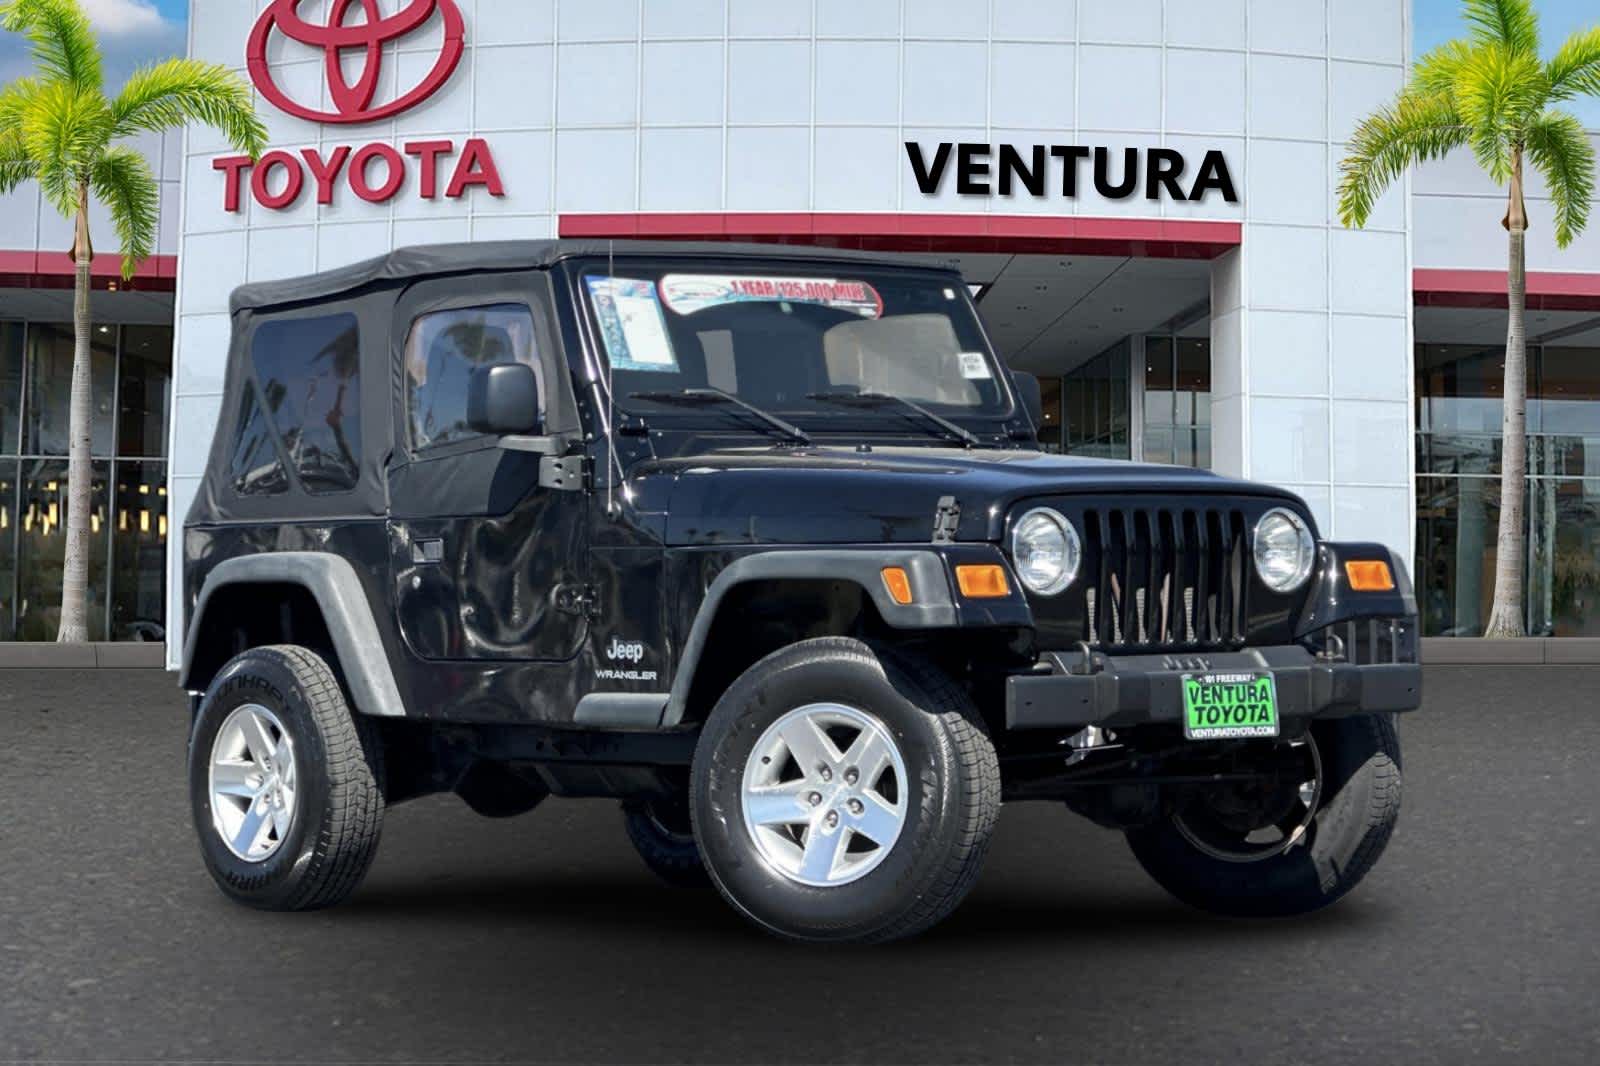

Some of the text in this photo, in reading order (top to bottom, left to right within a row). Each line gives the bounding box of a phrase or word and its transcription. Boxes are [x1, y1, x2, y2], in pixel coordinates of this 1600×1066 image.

[213, 138, 505, 213] TOYOTA
[904, 141, 1238, 202] VENTURA
[607, 639, 643, 664] Jeep
[595, 670, 657, 680] WRANGLER
[1189, 685, 1269, 704] VENTURA
[1193, 704, 1270, 725] TOYOTA
[1191, 726, 1275, 738] VENTURATOYOTA.COM
